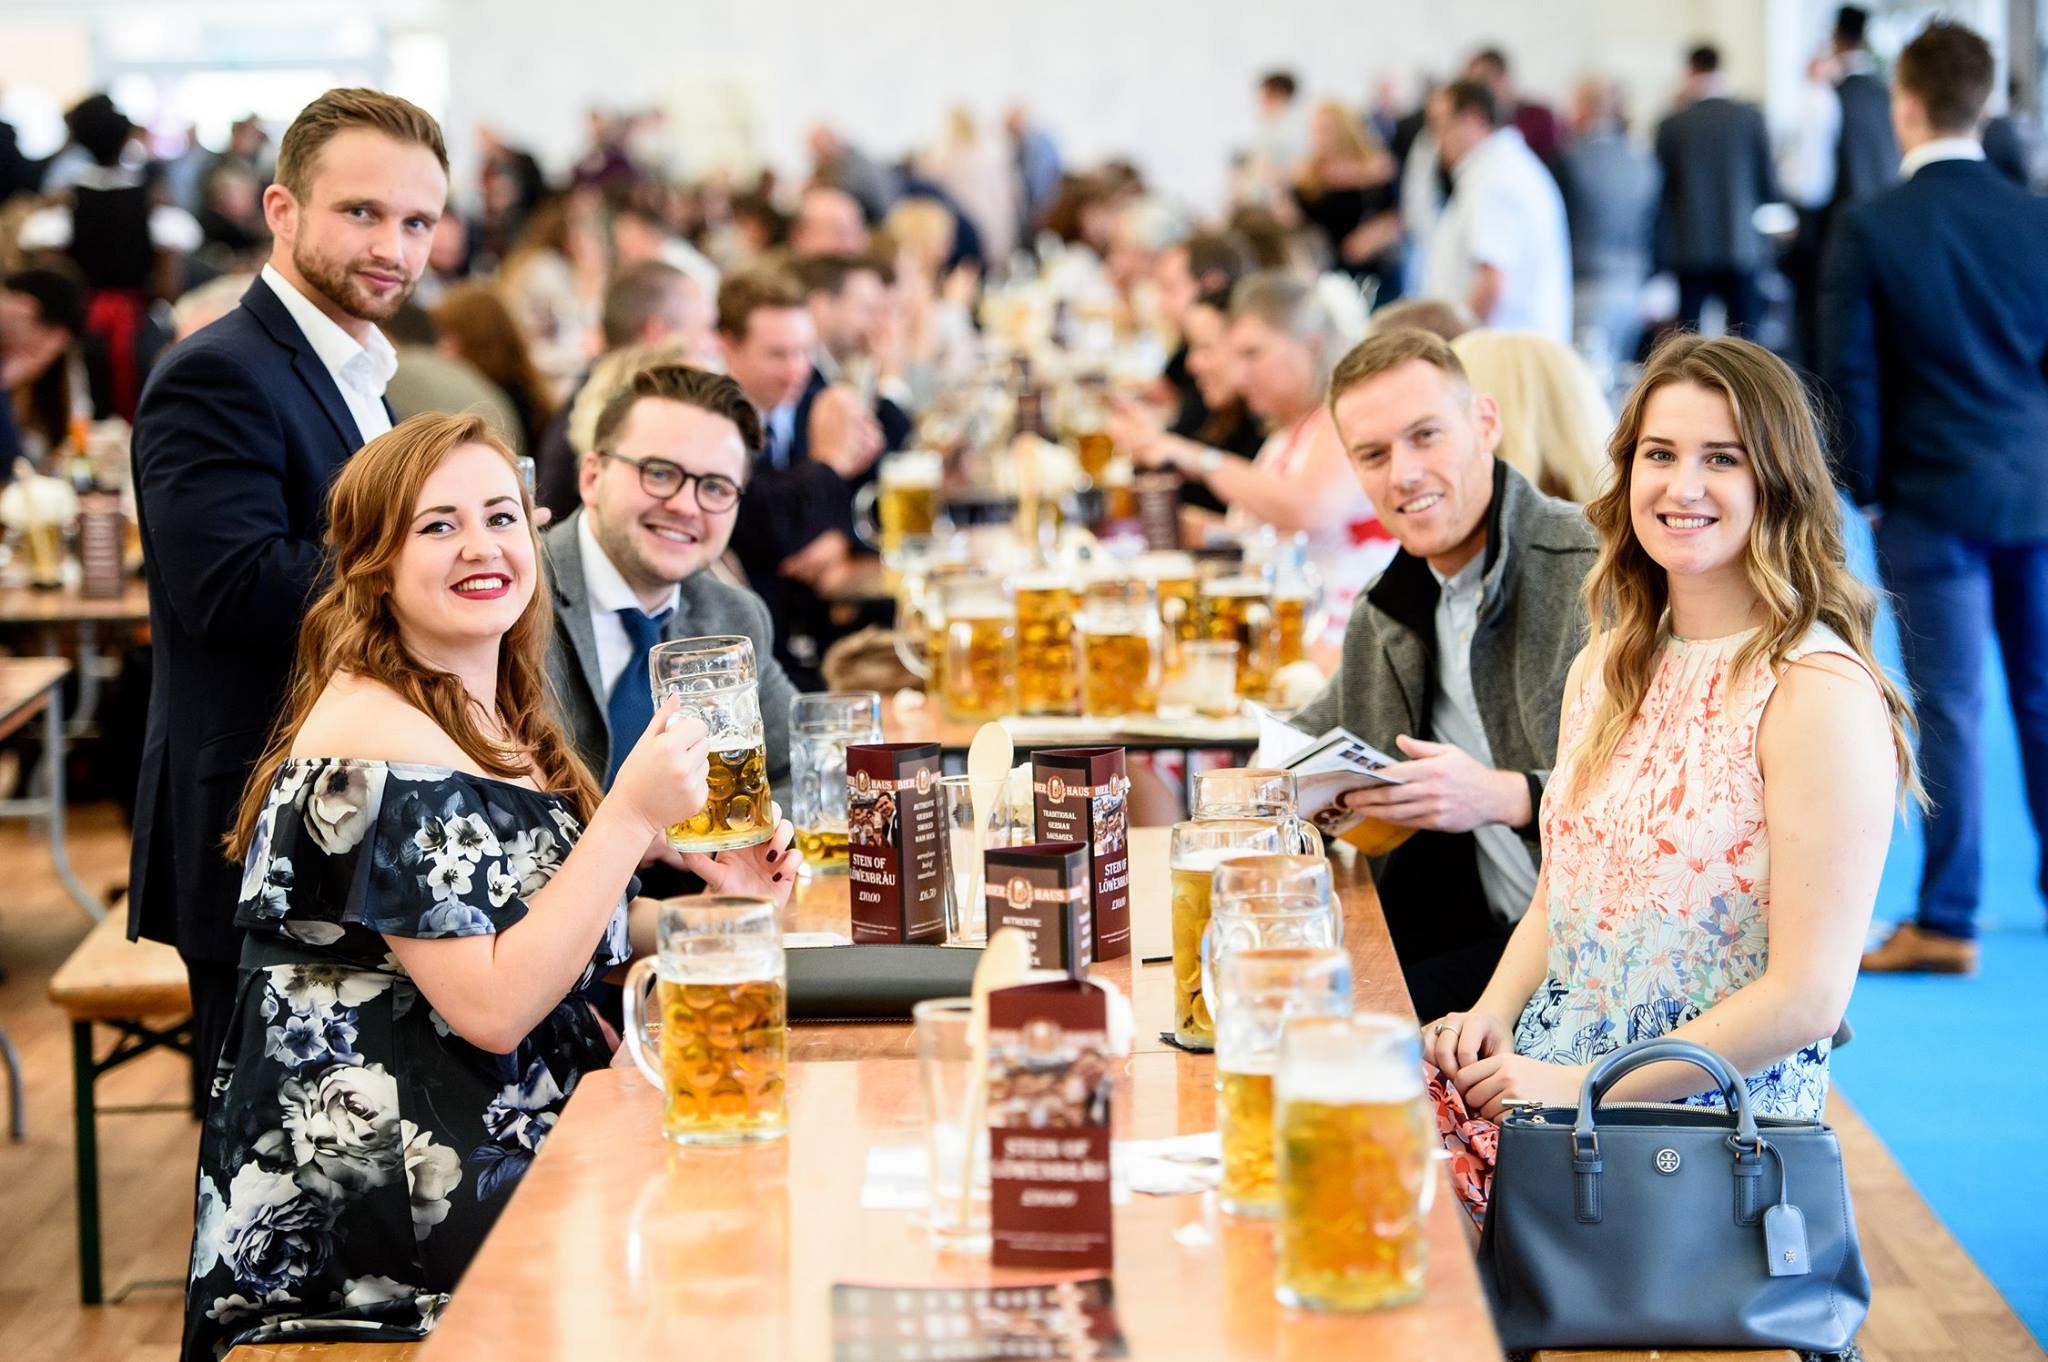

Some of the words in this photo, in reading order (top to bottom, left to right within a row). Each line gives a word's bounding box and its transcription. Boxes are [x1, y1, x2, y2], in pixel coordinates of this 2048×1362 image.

[871, 780, 893, 791] HAUS
[897, 778, 915, 790] BIER
[1066, 786, 1090, 797] HAUS
[1042, 809, 1077, 820] TRADITIONAL
[1047, 821, 1070, 831] GERMAN
[1046, 831, 1073, 842] SAUSAGES
[852, 853, 873, 868] STEIN
[873, 857, 886, 869] OF
[1104, 862, 1121, 876] STEIN
[858, 890, 881, 904] £10.00
